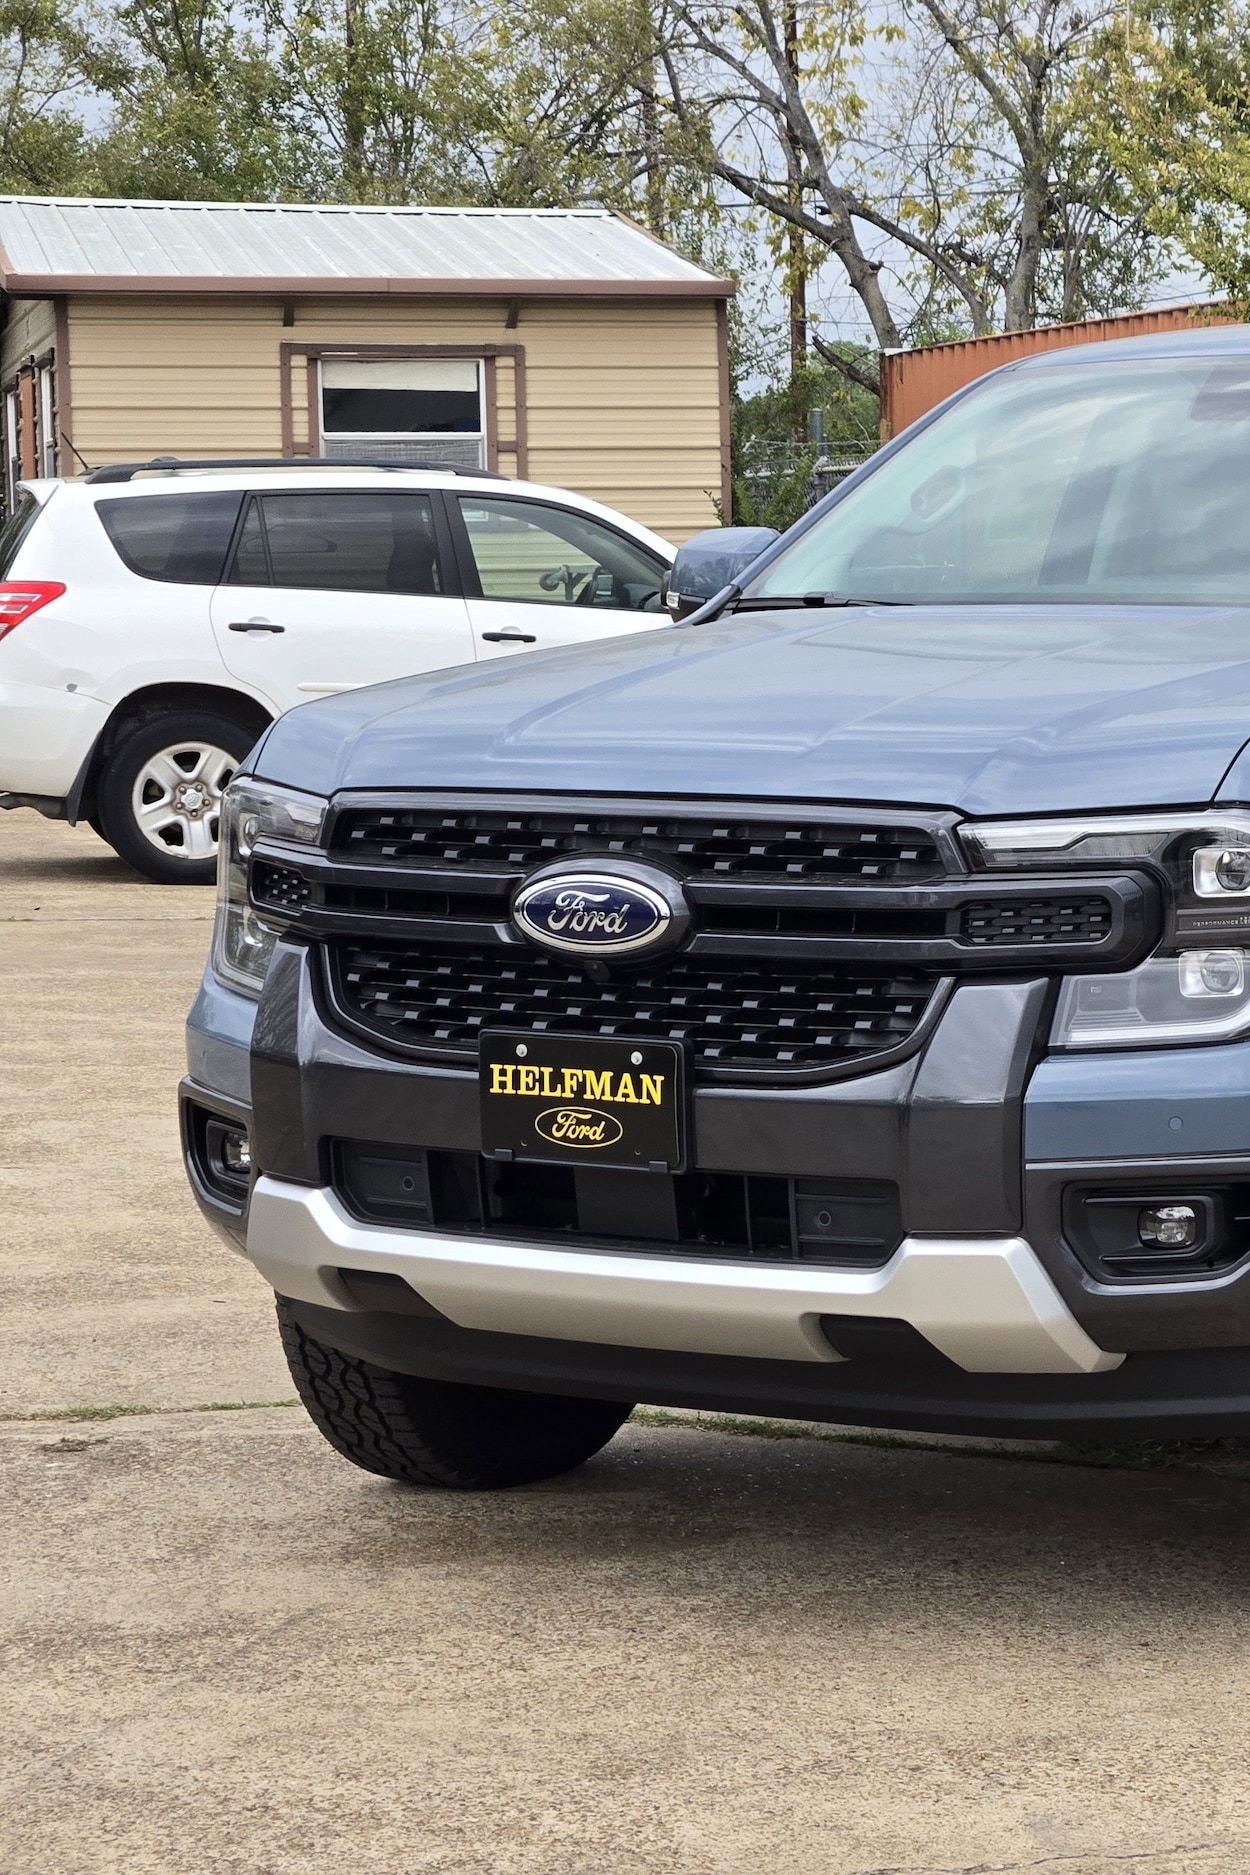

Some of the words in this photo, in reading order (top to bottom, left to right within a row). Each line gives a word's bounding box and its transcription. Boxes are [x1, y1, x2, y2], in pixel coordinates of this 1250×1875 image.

[547, 890, 630, 934] Ford
[489, 1063, 664, 1106] HELFMAN
[551, 1110, 606, 1142] Ford
